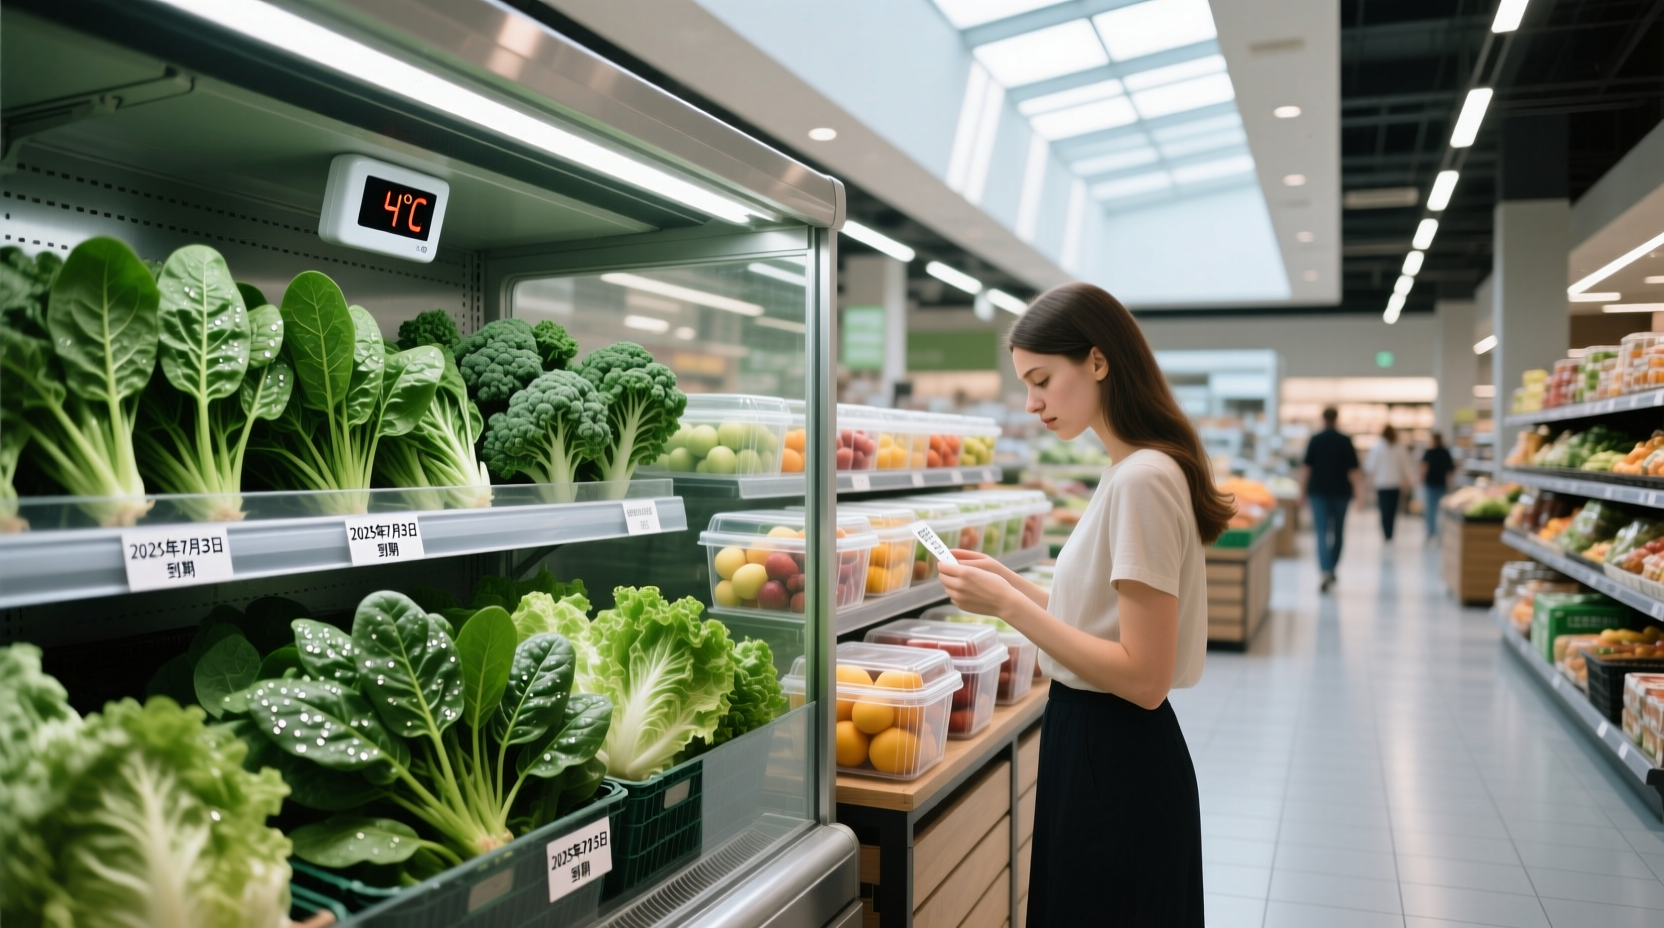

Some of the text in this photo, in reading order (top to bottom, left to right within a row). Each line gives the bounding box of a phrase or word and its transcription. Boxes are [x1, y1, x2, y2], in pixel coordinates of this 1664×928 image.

[384, 190, 428, 233] 4°C
[349, 522, 418, 541] 2025年7月3日
[130, 536, 224, 559] 2025年7月3日
[377, 542, 399, 558] 到期
[167, 560, 196, 579] 到期
